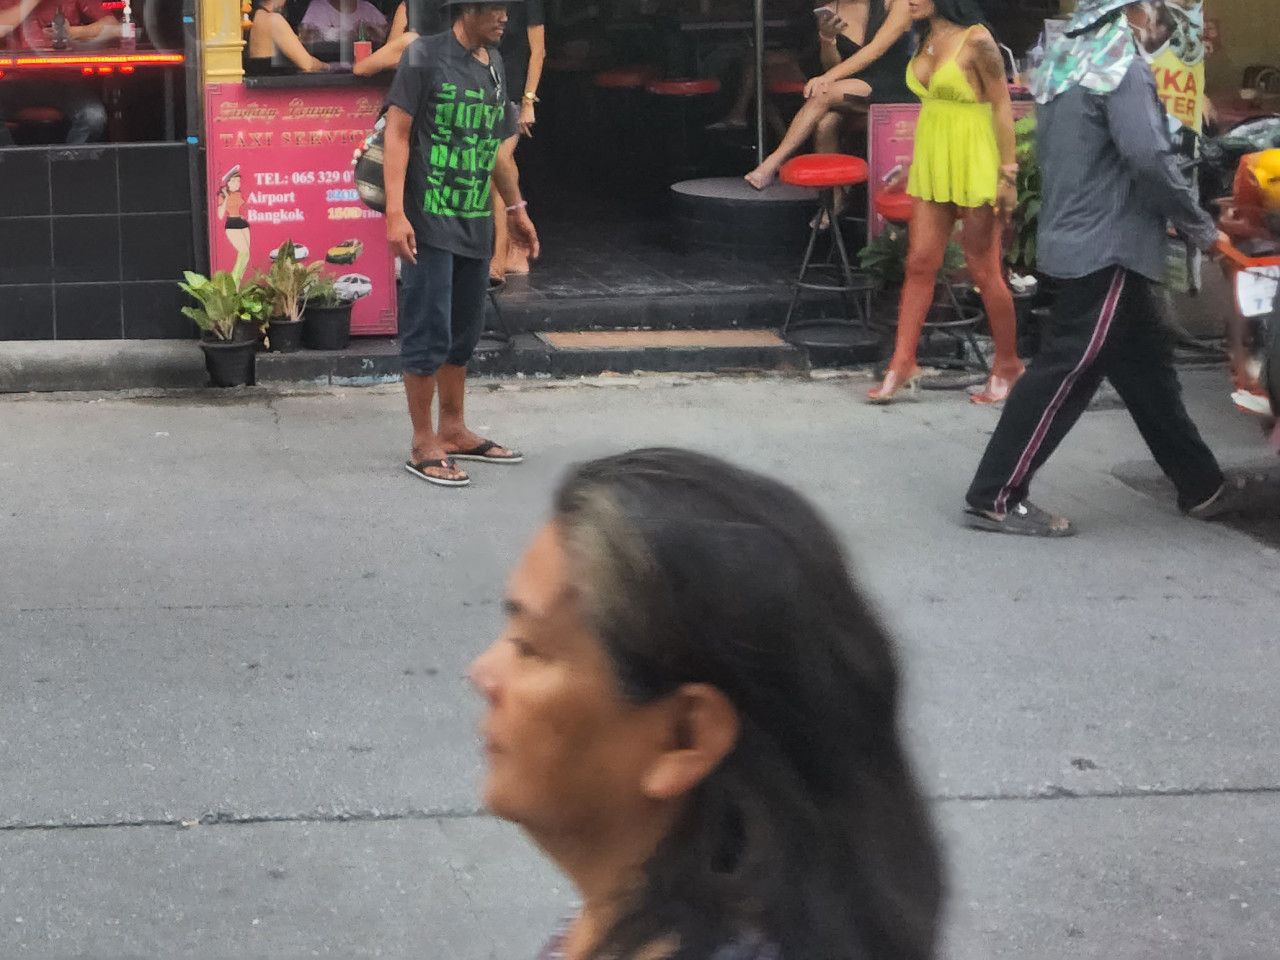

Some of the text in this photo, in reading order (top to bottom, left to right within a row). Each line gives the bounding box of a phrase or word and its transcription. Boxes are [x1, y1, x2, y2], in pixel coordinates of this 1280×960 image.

[220, 130, 274, 147] TAXI
[255, 172, 288, 186] TEL:
[247, 191, 296, 205] Airport
[247, 208, 305, 225] Bangkok
